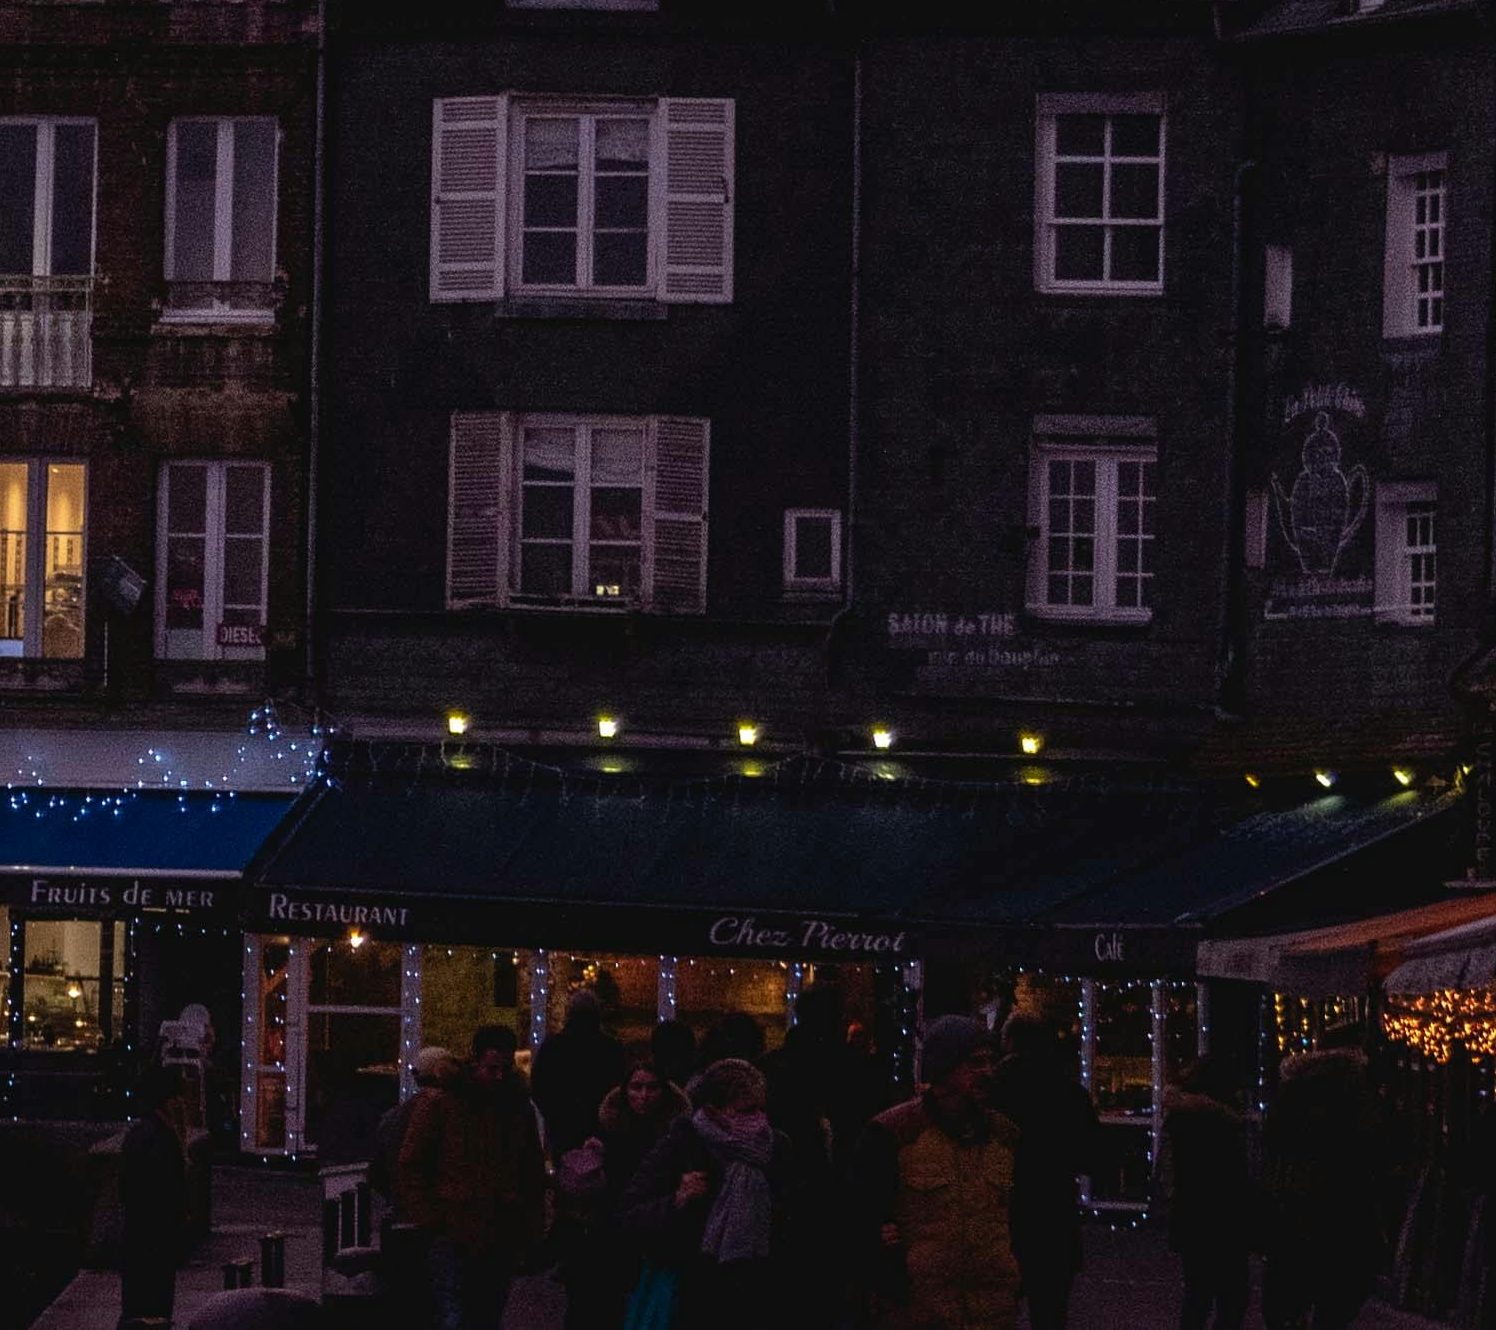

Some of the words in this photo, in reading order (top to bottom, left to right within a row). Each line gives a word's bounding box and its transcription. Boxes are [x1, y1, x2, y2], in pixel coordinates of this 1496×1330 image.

[166, 888, 214, 908] MER
[268, 892, 409, 927] RESTAURANT
[709, 916, 789, 947] Chez
[799, 919, 906, 953] Pierrot
